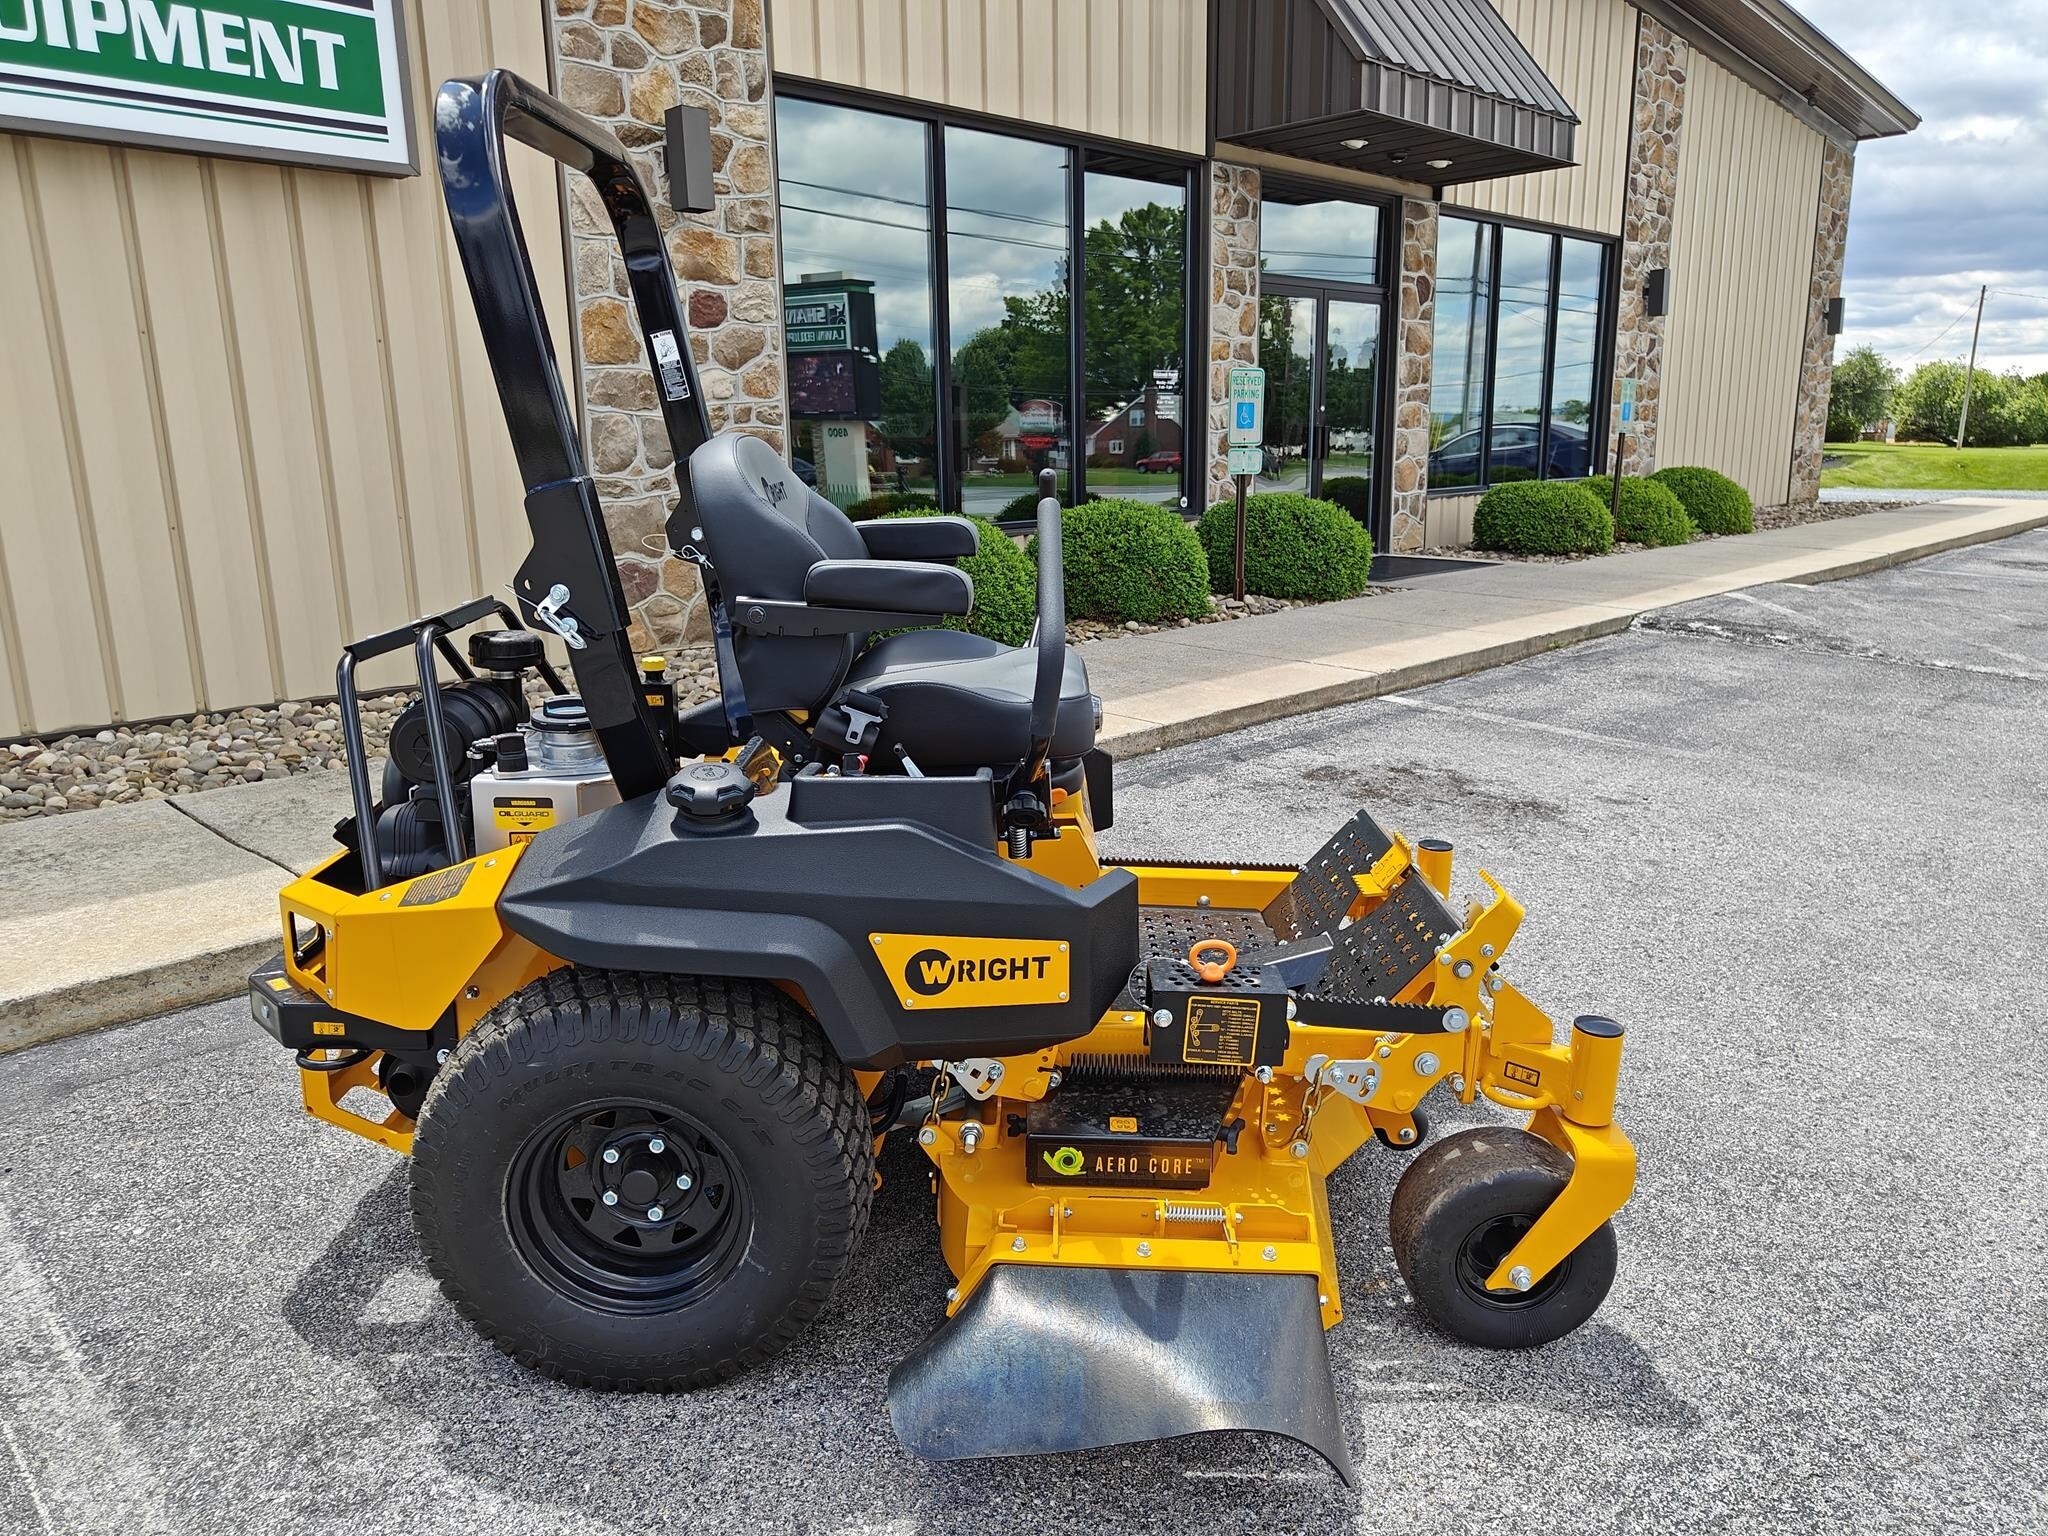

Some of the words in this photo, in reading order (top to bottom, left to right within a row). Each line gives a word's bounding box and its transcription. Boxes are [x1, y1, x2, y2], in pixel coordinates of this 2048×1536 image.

[1233, 375, 1262, 386] RESERVED
[1233, 389, 1260, 399] PARKING
[913, 954, 1051, 989] WRIGHT
[1095, 1156, 1138, 1173] AERO
